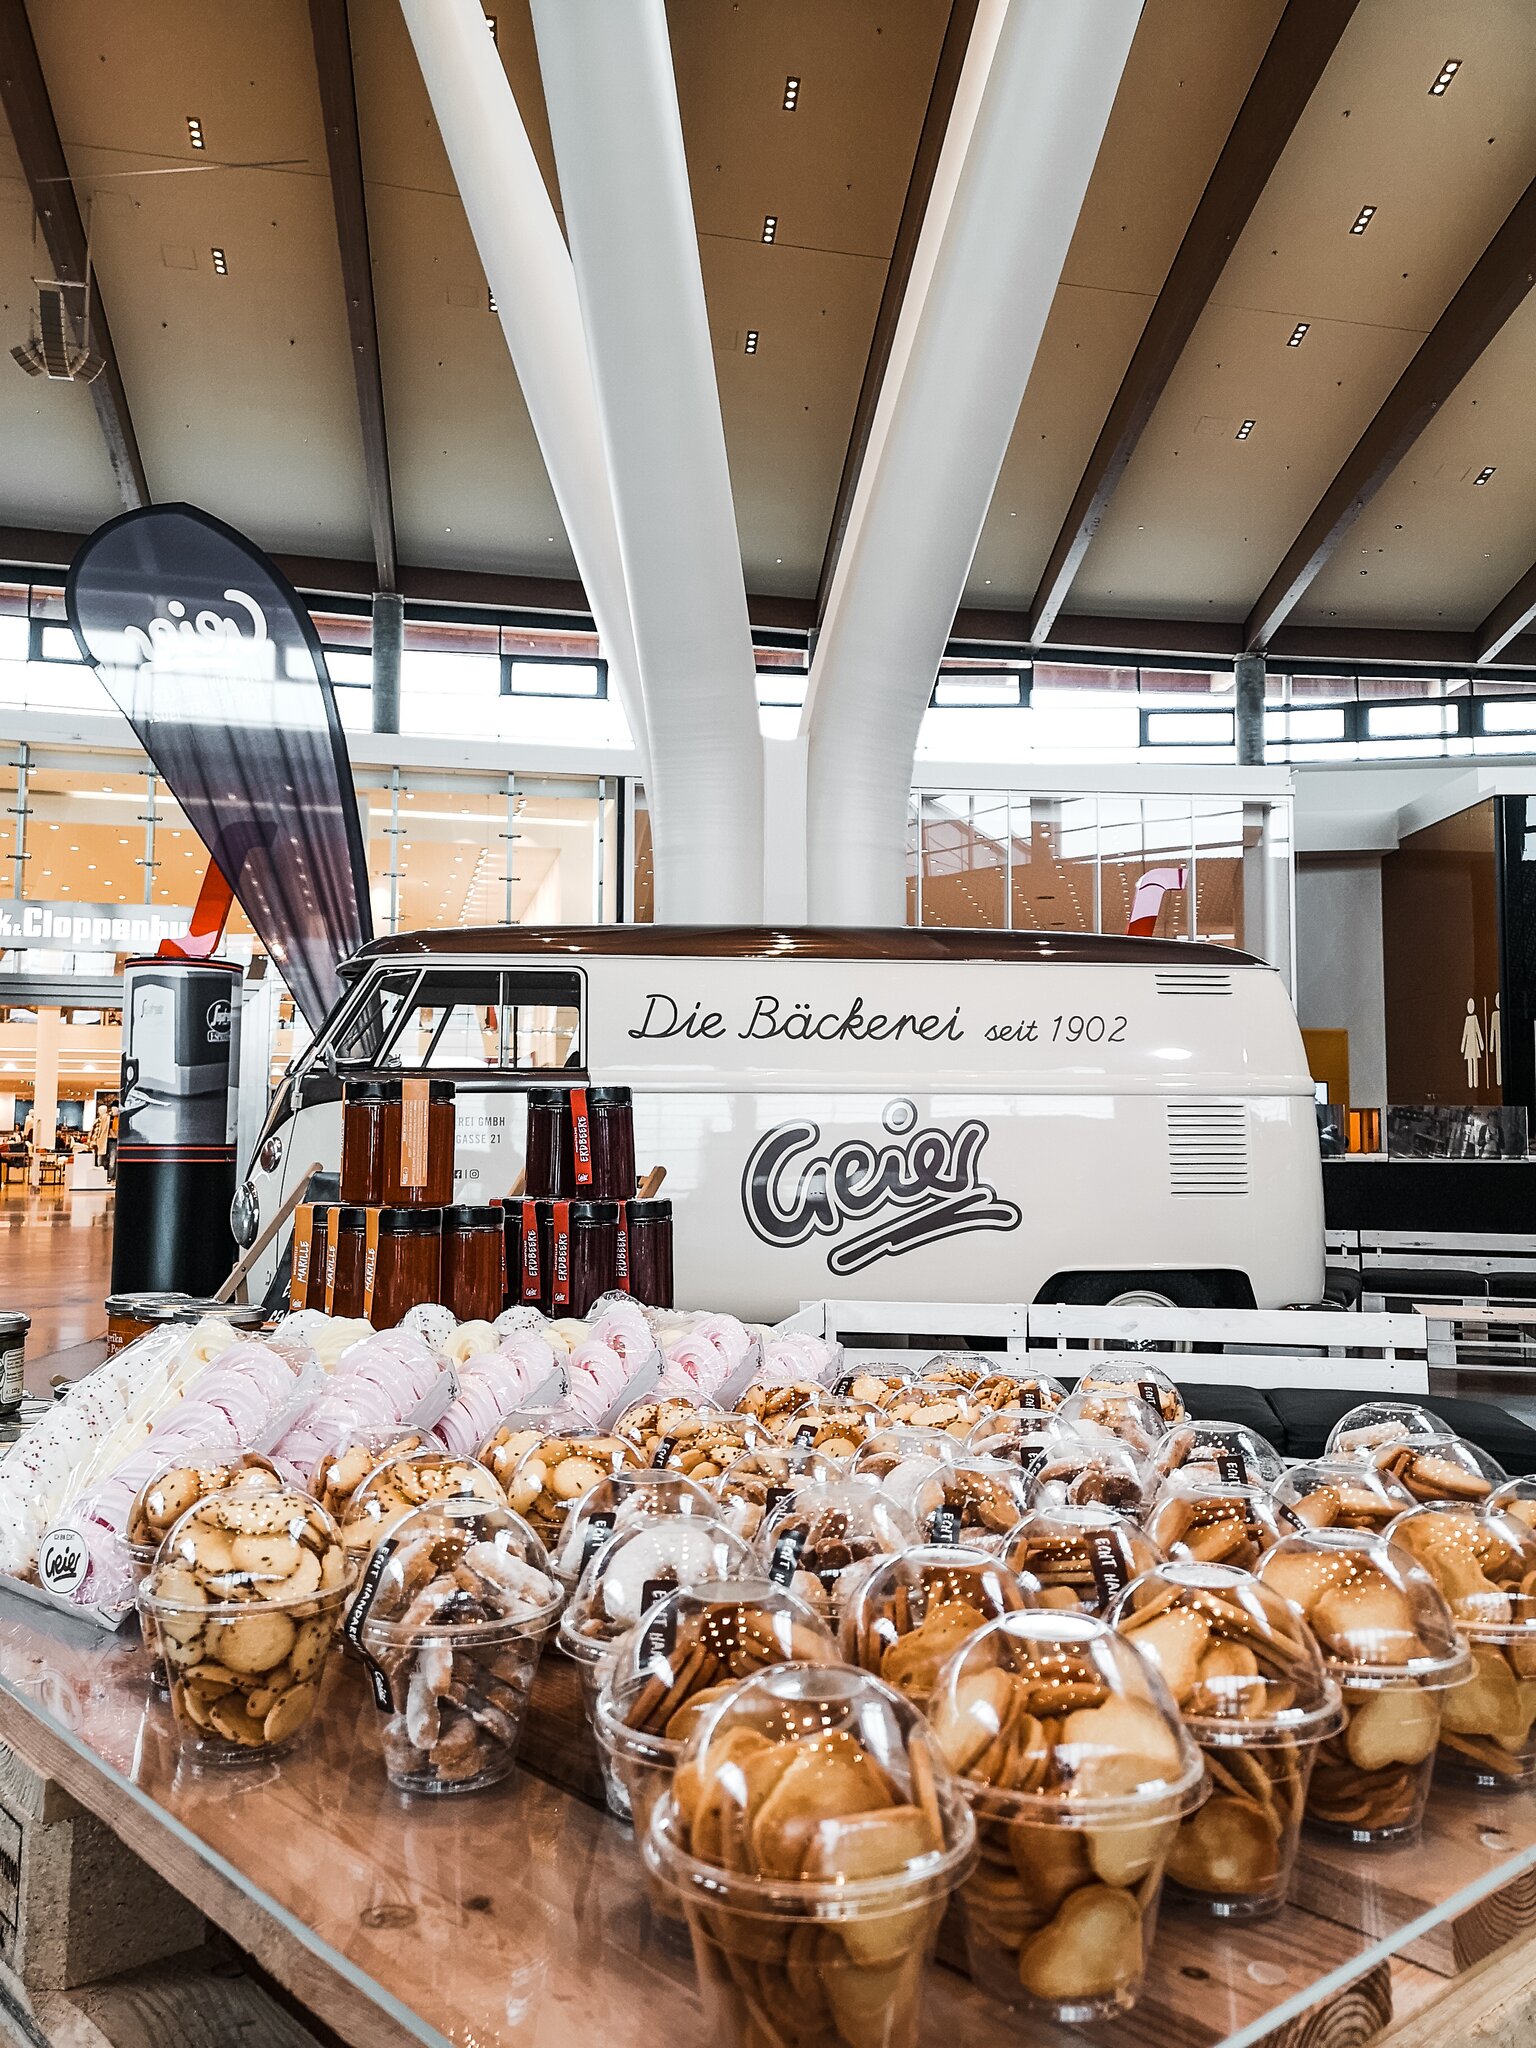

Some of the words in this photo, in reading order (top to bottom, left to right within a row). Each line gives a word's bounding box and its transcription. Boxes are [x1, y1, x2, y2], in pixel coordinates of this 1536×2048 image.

[628, 994, 726, 1040] Die
[738, 995, 965, 1041] Bäckerei
[984, 1020, 1039, 1042] seit
[1051, 1015, 1128, 1042] 1902
[456, 1117, 474, 1127] REI
[479, 1117, 505, 1127] GMBH
[490, 1134, 501, 1144] 21
[578, 1116, 588, 1162] ERDBEERE
[740, 1097, 1022, 1275] Geier
[297, 1240, 309, 1283] MARILLE
[528, 1230, 538, 1276] ERDBEERE
[558, 1233, 568, 1281] ERDBEERE
[617, 1230, 627, 1277] ERDBEERE
[45, 1546, 81, 1582] Geier
[371, 1547, 390, 1578] ECHT
[779, 1538, 797, 1570] ECHT
[1095, 1538, 1117, 1568] ECHT
